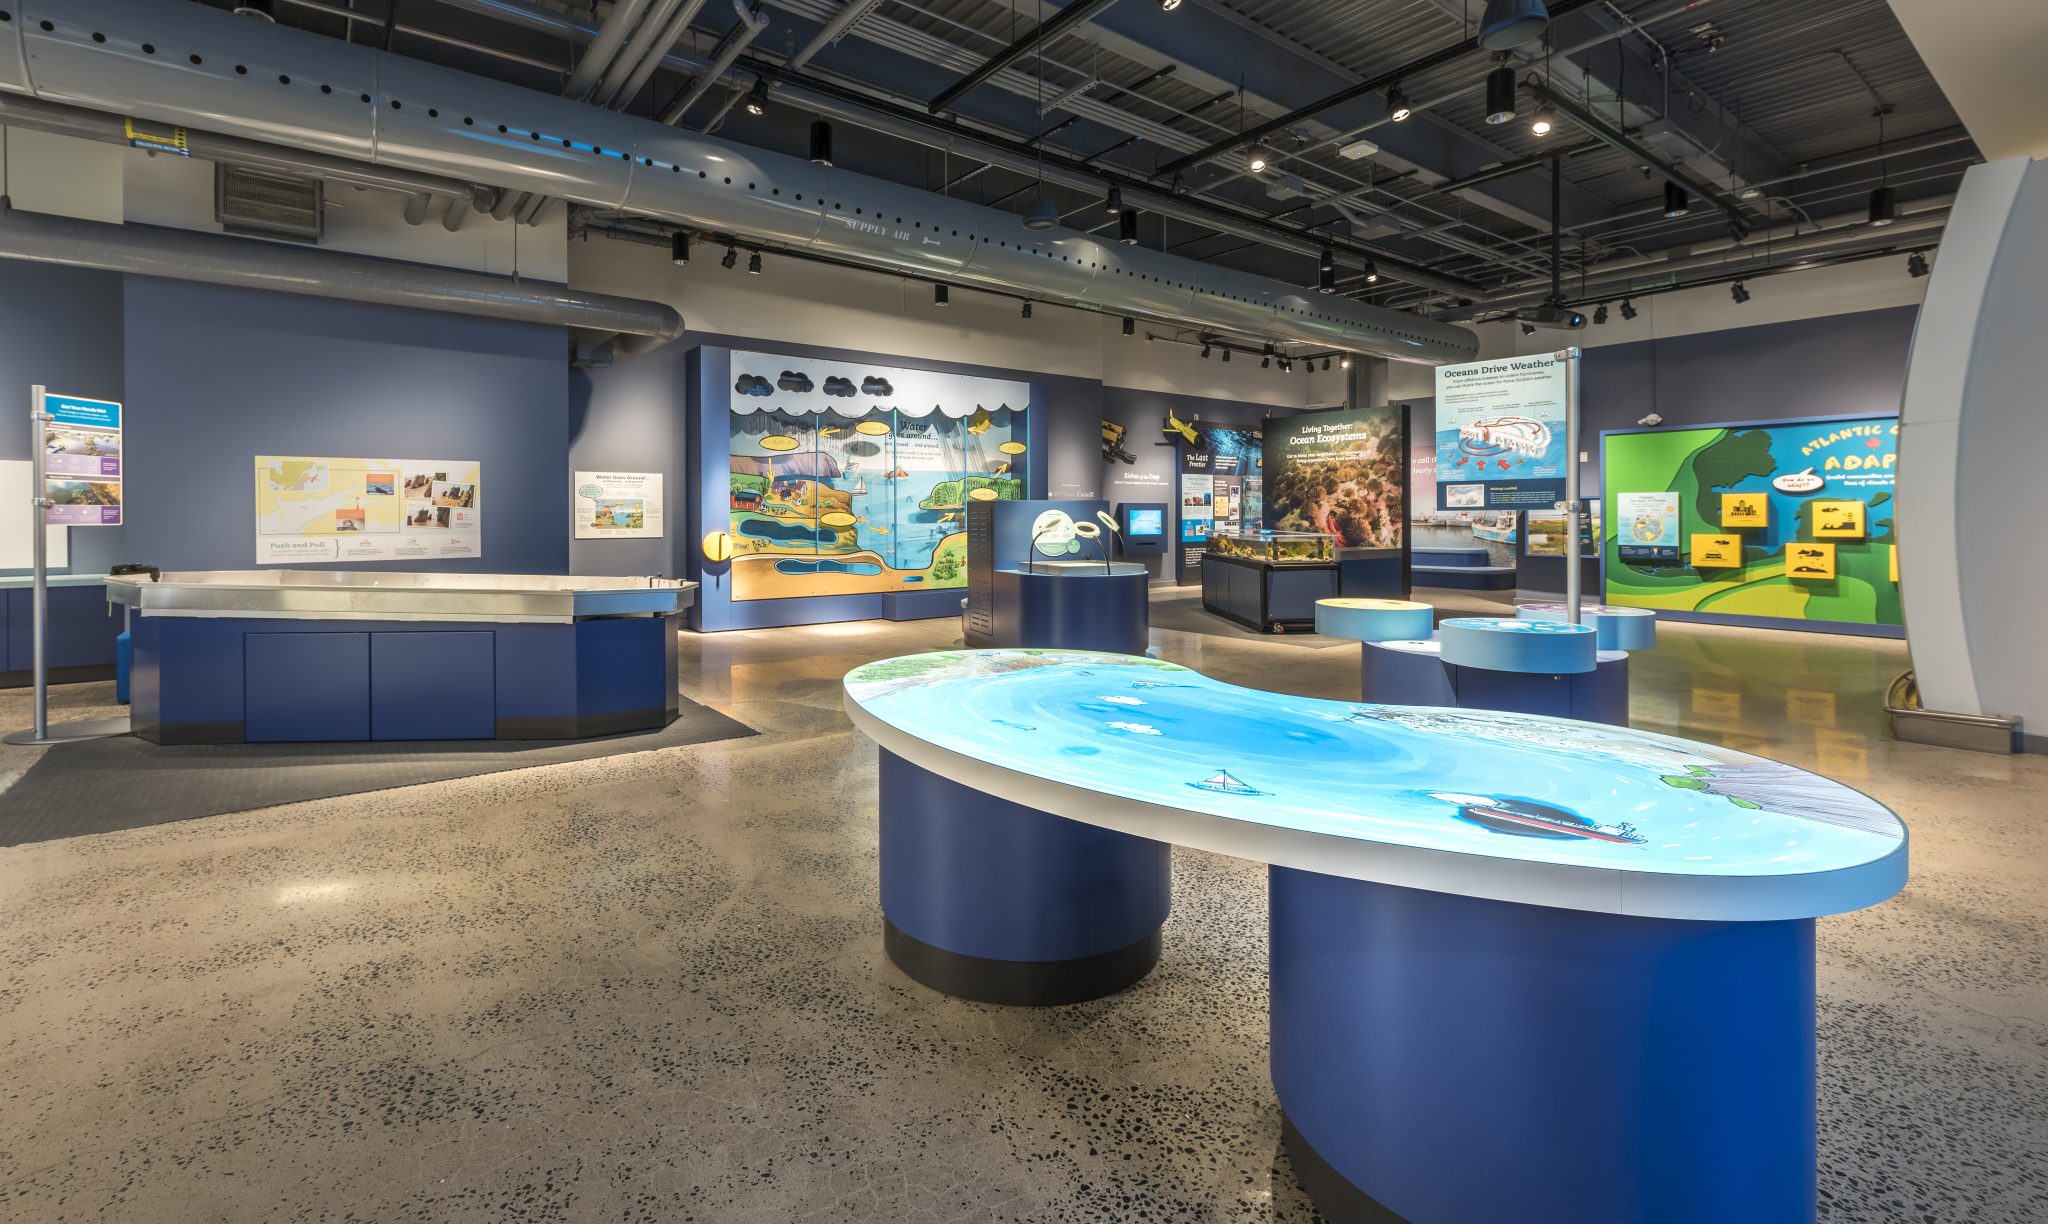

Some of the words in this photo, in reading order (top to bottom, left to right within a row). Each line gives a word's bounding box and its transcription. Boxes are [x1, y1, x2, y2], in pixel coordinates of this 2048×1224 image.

[846, 219, 888, 236] SUPPLY
[891, 230, 910, 241] AIR
[1444, 368, 1479, 378] Oceans
[1481, 365, 1508, 374] Drive
[1510, 359, 1555, 371] Weather
[901, 421, 928, 432] Water
[1302, 426, 1322, 434] Living
[1323, 422, 1353, 432] Together:
[1290, 436, 1315, 445] Ocean
[1317, 432, 1367, 444] Ecosystems
[1802, 425, 1882, 456] ATLANTIC
[1195, 453, 1208, 461] Last
[1149, 473, 1160, 481] Deep
